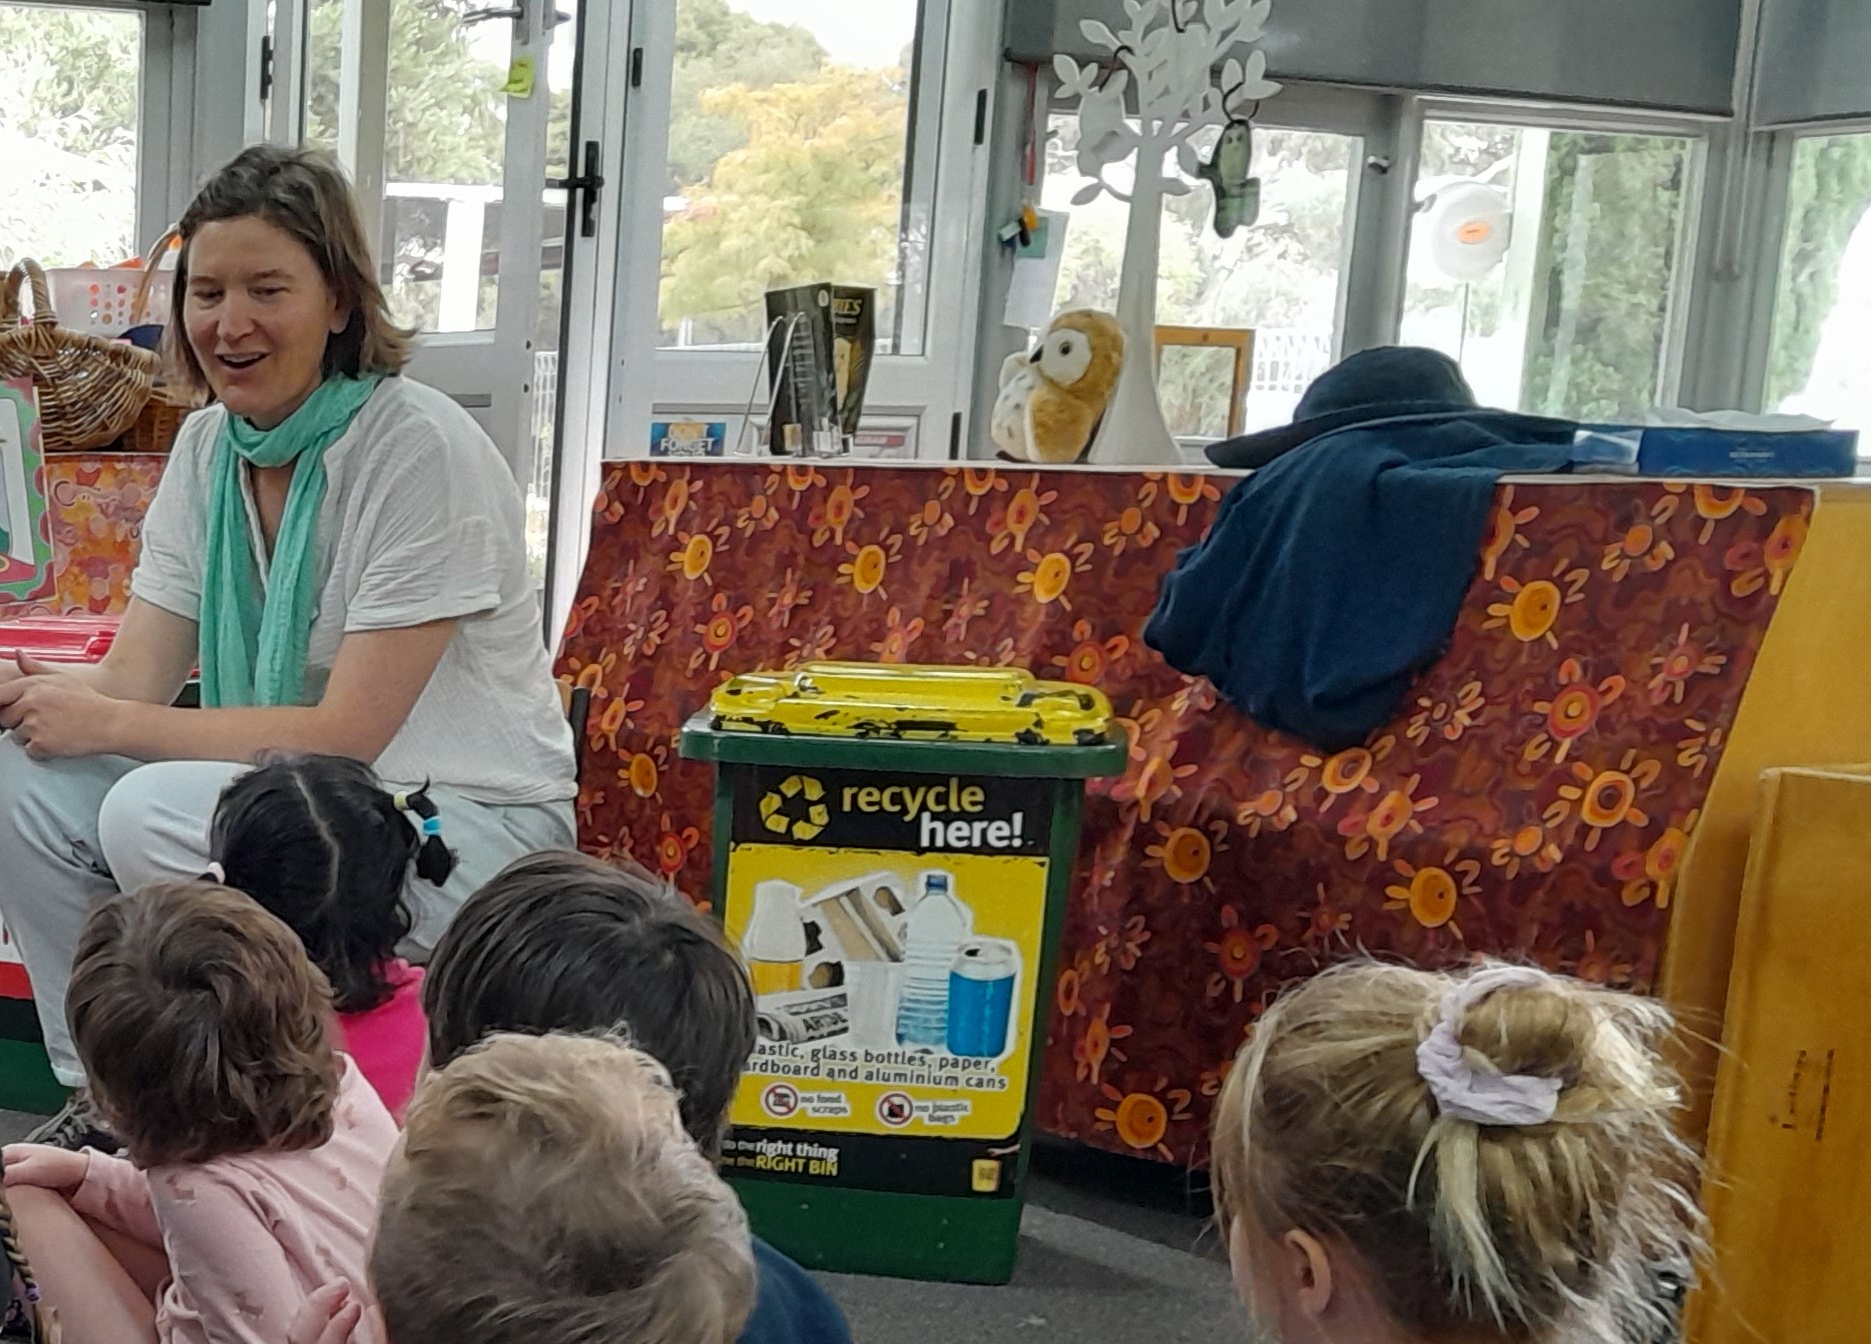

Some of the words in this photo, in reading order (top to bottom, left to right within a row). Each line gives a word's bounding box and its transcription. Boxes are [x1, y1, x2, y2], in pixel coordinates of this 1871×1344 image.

[841, 776, 986, 823] recycle
[920, 811, 1024, 848] here!
[754, 1042, 805, 1060] astic,
[810, 1045, 858, 1063] glass
[864, 1049, 933, 1068] bottles,
[939, 1056, 996, 1074] paper,
[745, 1060, 821, 1077] rdboard
[826, 1066, 859, 1081] and
[864, 1067, 960, 1087] aluminium
[965, 1076, 1007, 1090] cans
[755, 1138, 793, 1158] right
[795, 1142, 840, 1163] thing
[755, 1155, 808, 1173] RIGHT
[809, 1160, 839, 1177] BIN
